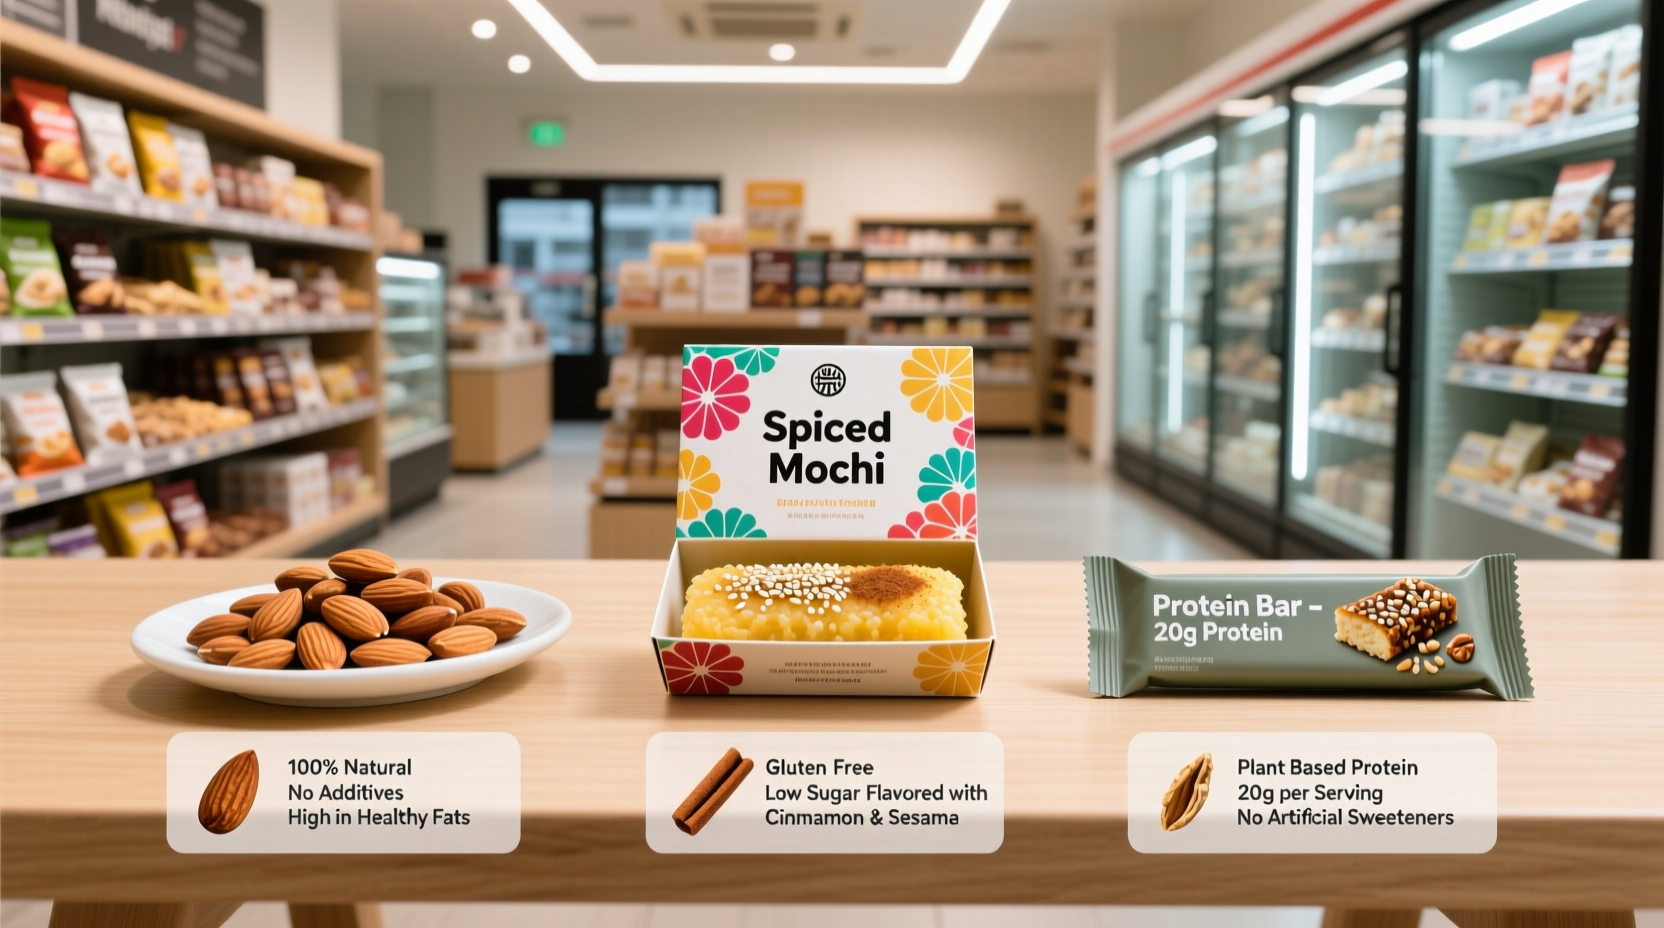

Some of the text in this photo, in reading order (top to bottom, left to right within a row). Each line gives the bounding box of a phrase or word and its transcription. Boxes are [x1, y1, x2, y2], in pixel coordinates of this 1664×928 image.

[763, 410, 891, 449] Spiced
[769, 452, 885, 484] Mochi
[1153, 594, 1249, 617] Protein
[1256, 594, 1302, 617] Bar
[1154, 622, 1283, 647] 20g Protein
